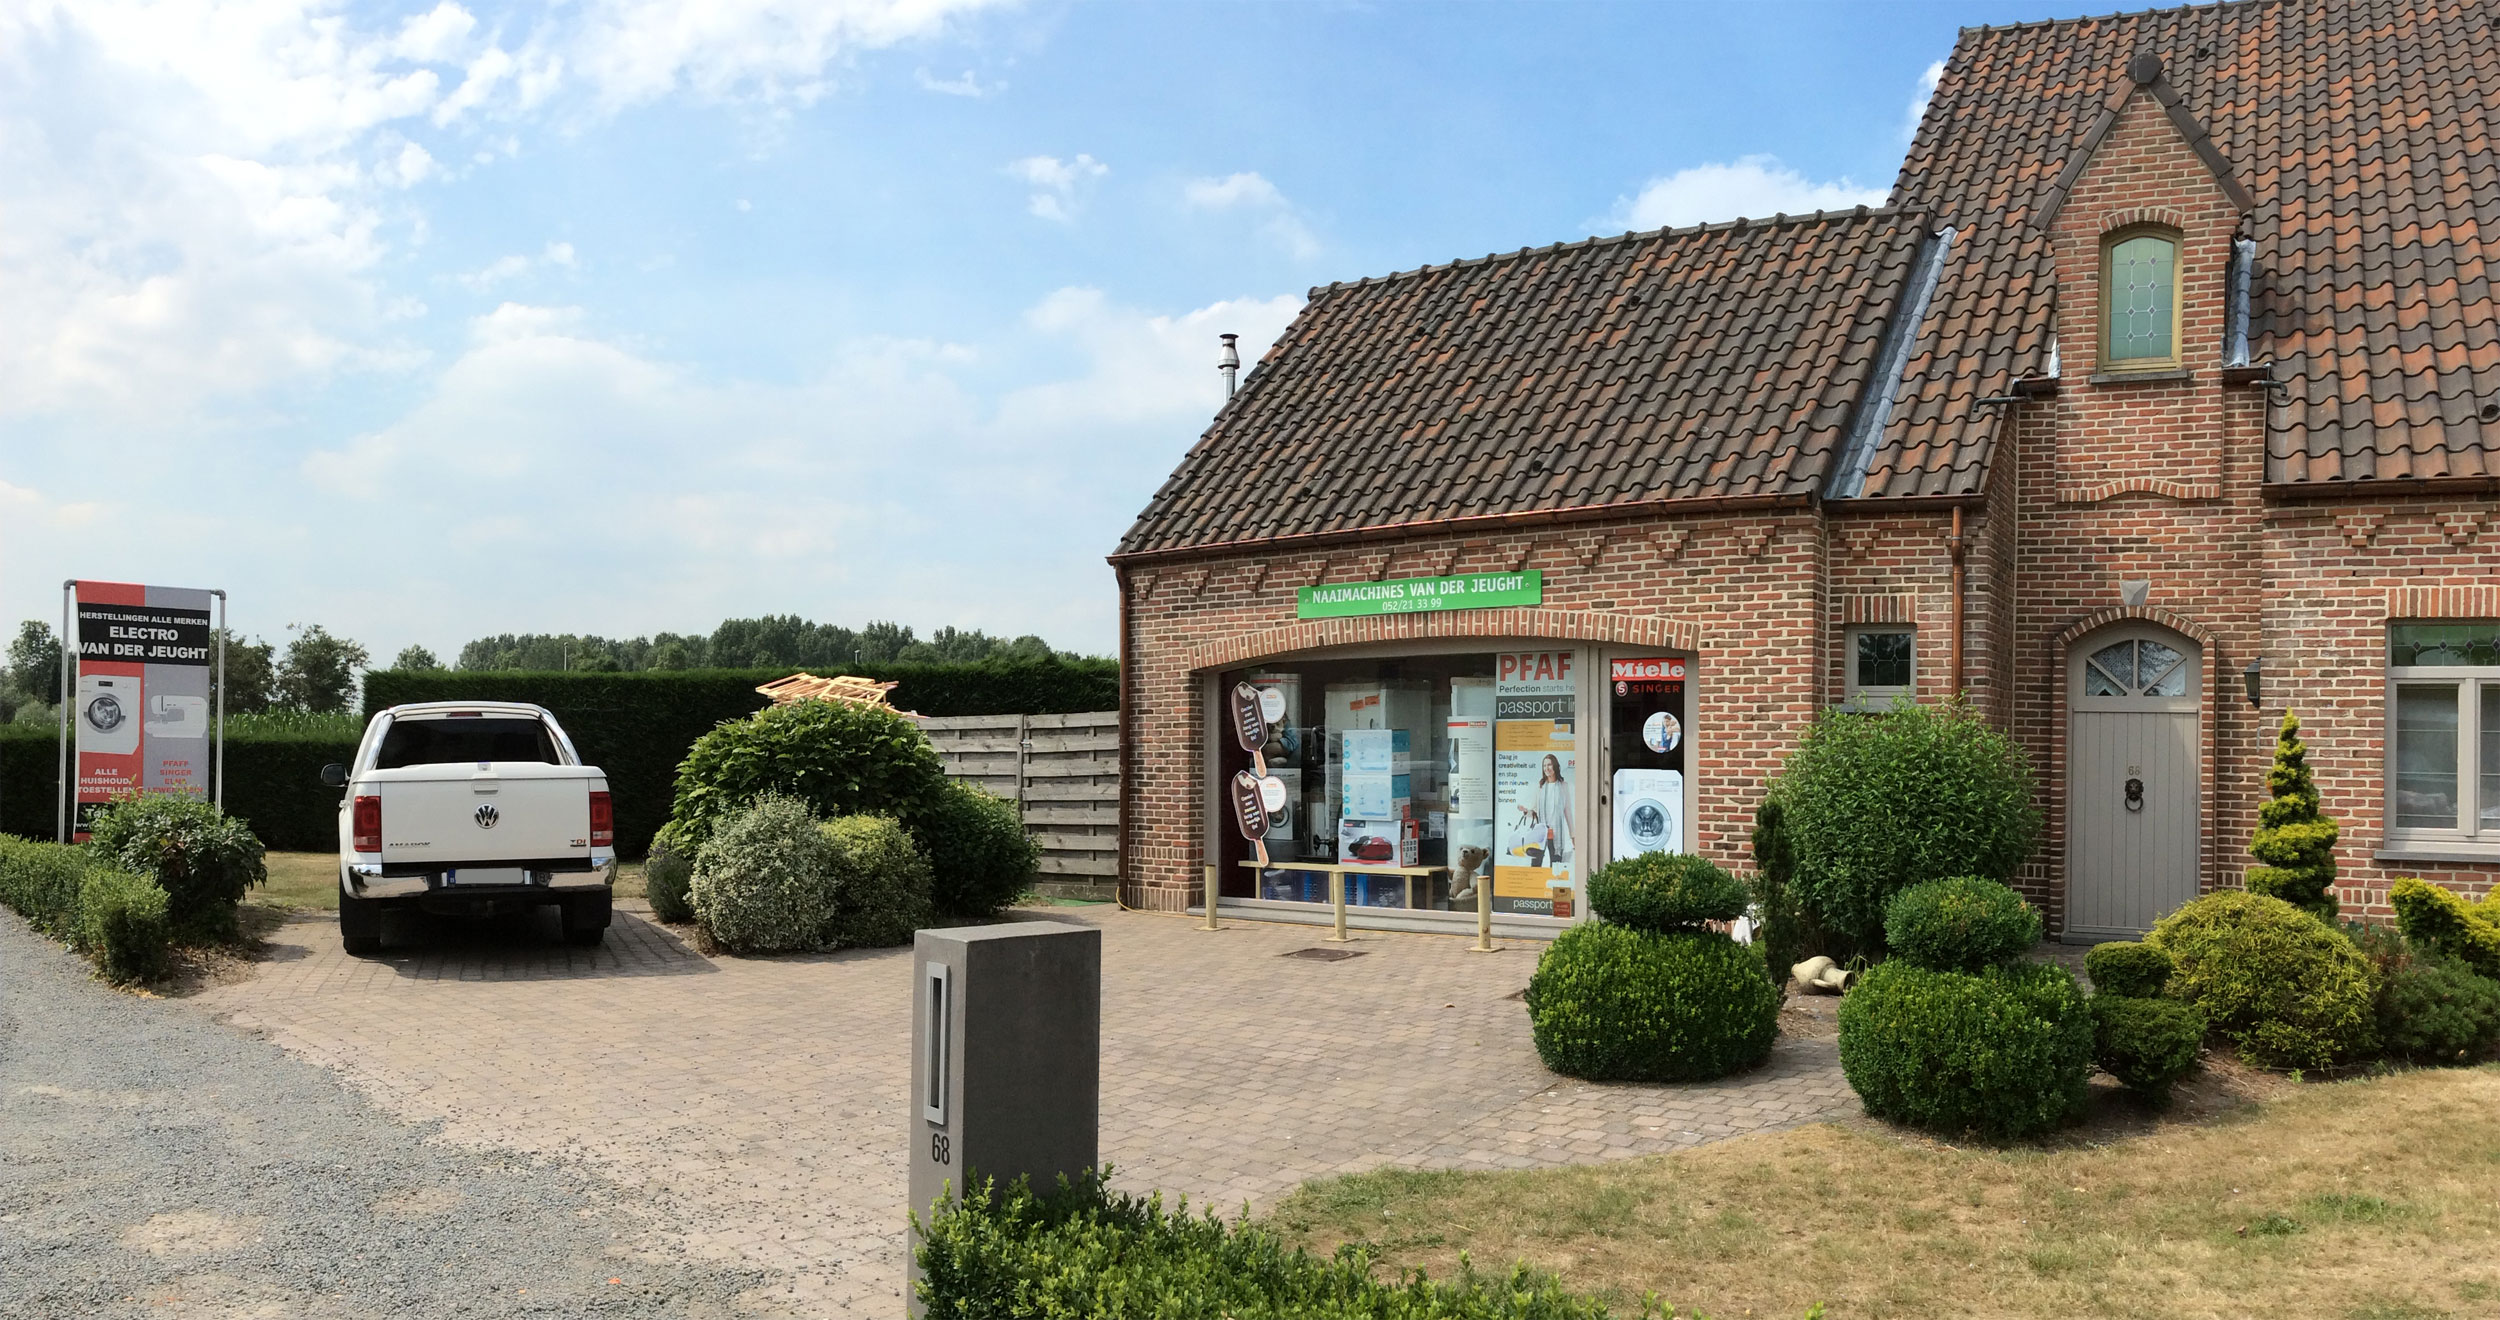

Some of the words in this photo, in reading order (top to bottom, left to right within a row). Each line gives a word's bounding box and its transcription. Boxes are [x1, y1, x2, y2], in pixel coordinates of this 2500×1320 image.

[1312, 583, 1404, 604] NAAIMACHINES
[1409, 582, 1435, 597] VAN
[1440, 580, 1465, 595] DER
[1471, 576, 1524, 593] JEUGHT
[1382, 600, 1413, 612] 052/21
[1417, 598, 1428, 609] 33
[1431, 598, 1442, 608] 99
[80, 611, 149, 623] HERSTELLINGEN
[151, 616, 172, 624] ALLE
[173, 617, 208, 626] MERKEN
[109, 626, 179, 641] ELECTRO
[79, 642, 109, 655] VAN
[114, 643, 144, 656] DER
[148, 646, 208, 659] JEUGHT
[1500, 653, 1572, 681] PFAF
[1612, 662, 1685, 677] Miele
[1499, 685, 1541, 693] Perfection
[1543, 685, 1564, 693] starts
[1632, 684, 1680, 693] SINGER
[1498, 698, 1567, 717] passport
[94, 768, 118, 776] ALLE
[160, 769, 192, 777] SINGER
[1513, 900, 1553, 910] passport
[932, 1133, 950, 1165] 68
